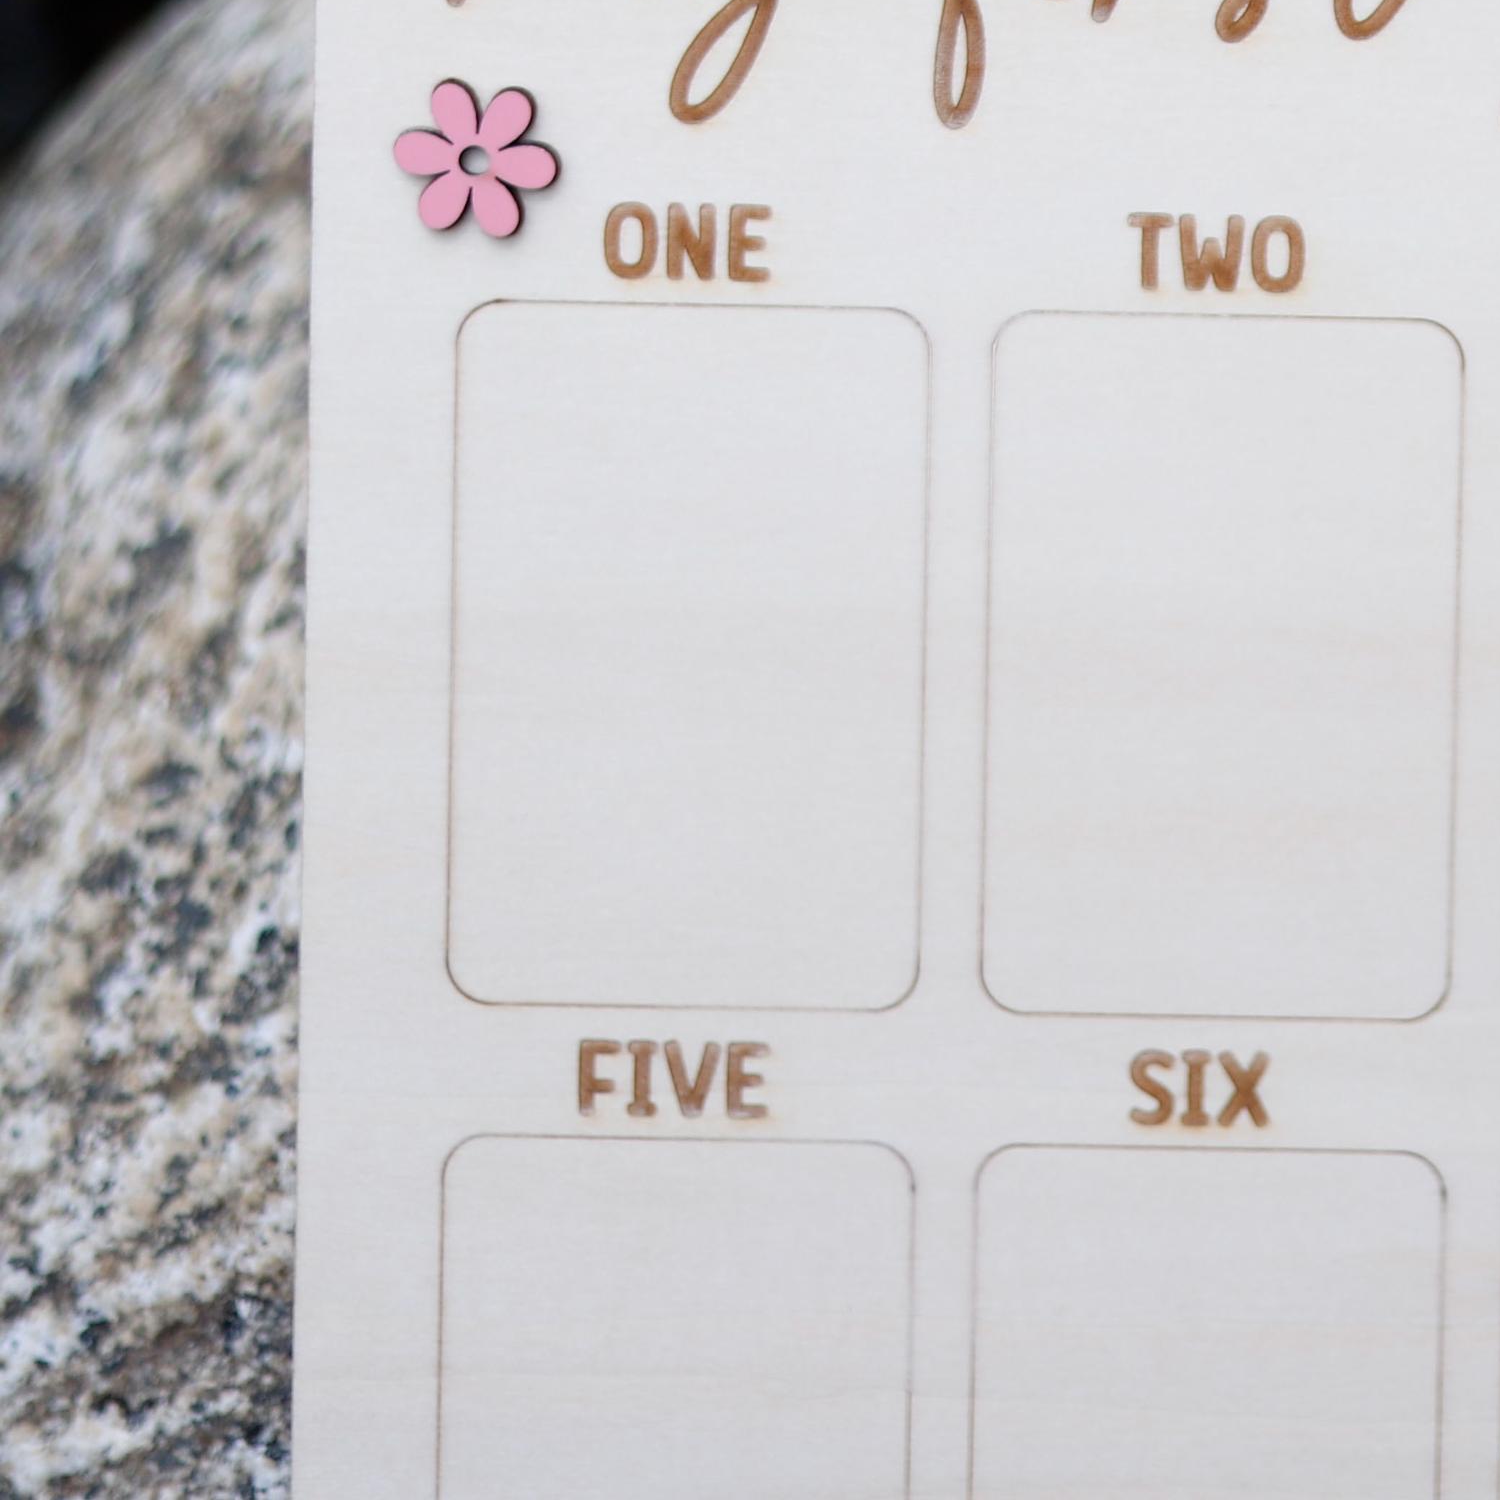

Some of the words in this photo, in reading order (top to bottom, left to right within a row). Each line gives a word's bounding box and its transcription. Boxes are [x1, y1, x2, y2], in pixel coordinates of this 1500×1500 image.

[604, 203, 770, 283] ONE
[1128, 213, 1304, 293] TWO
[578, 1040, 767, 1116] FIVE
[1130, 1052, 1270, 1130] SIX
